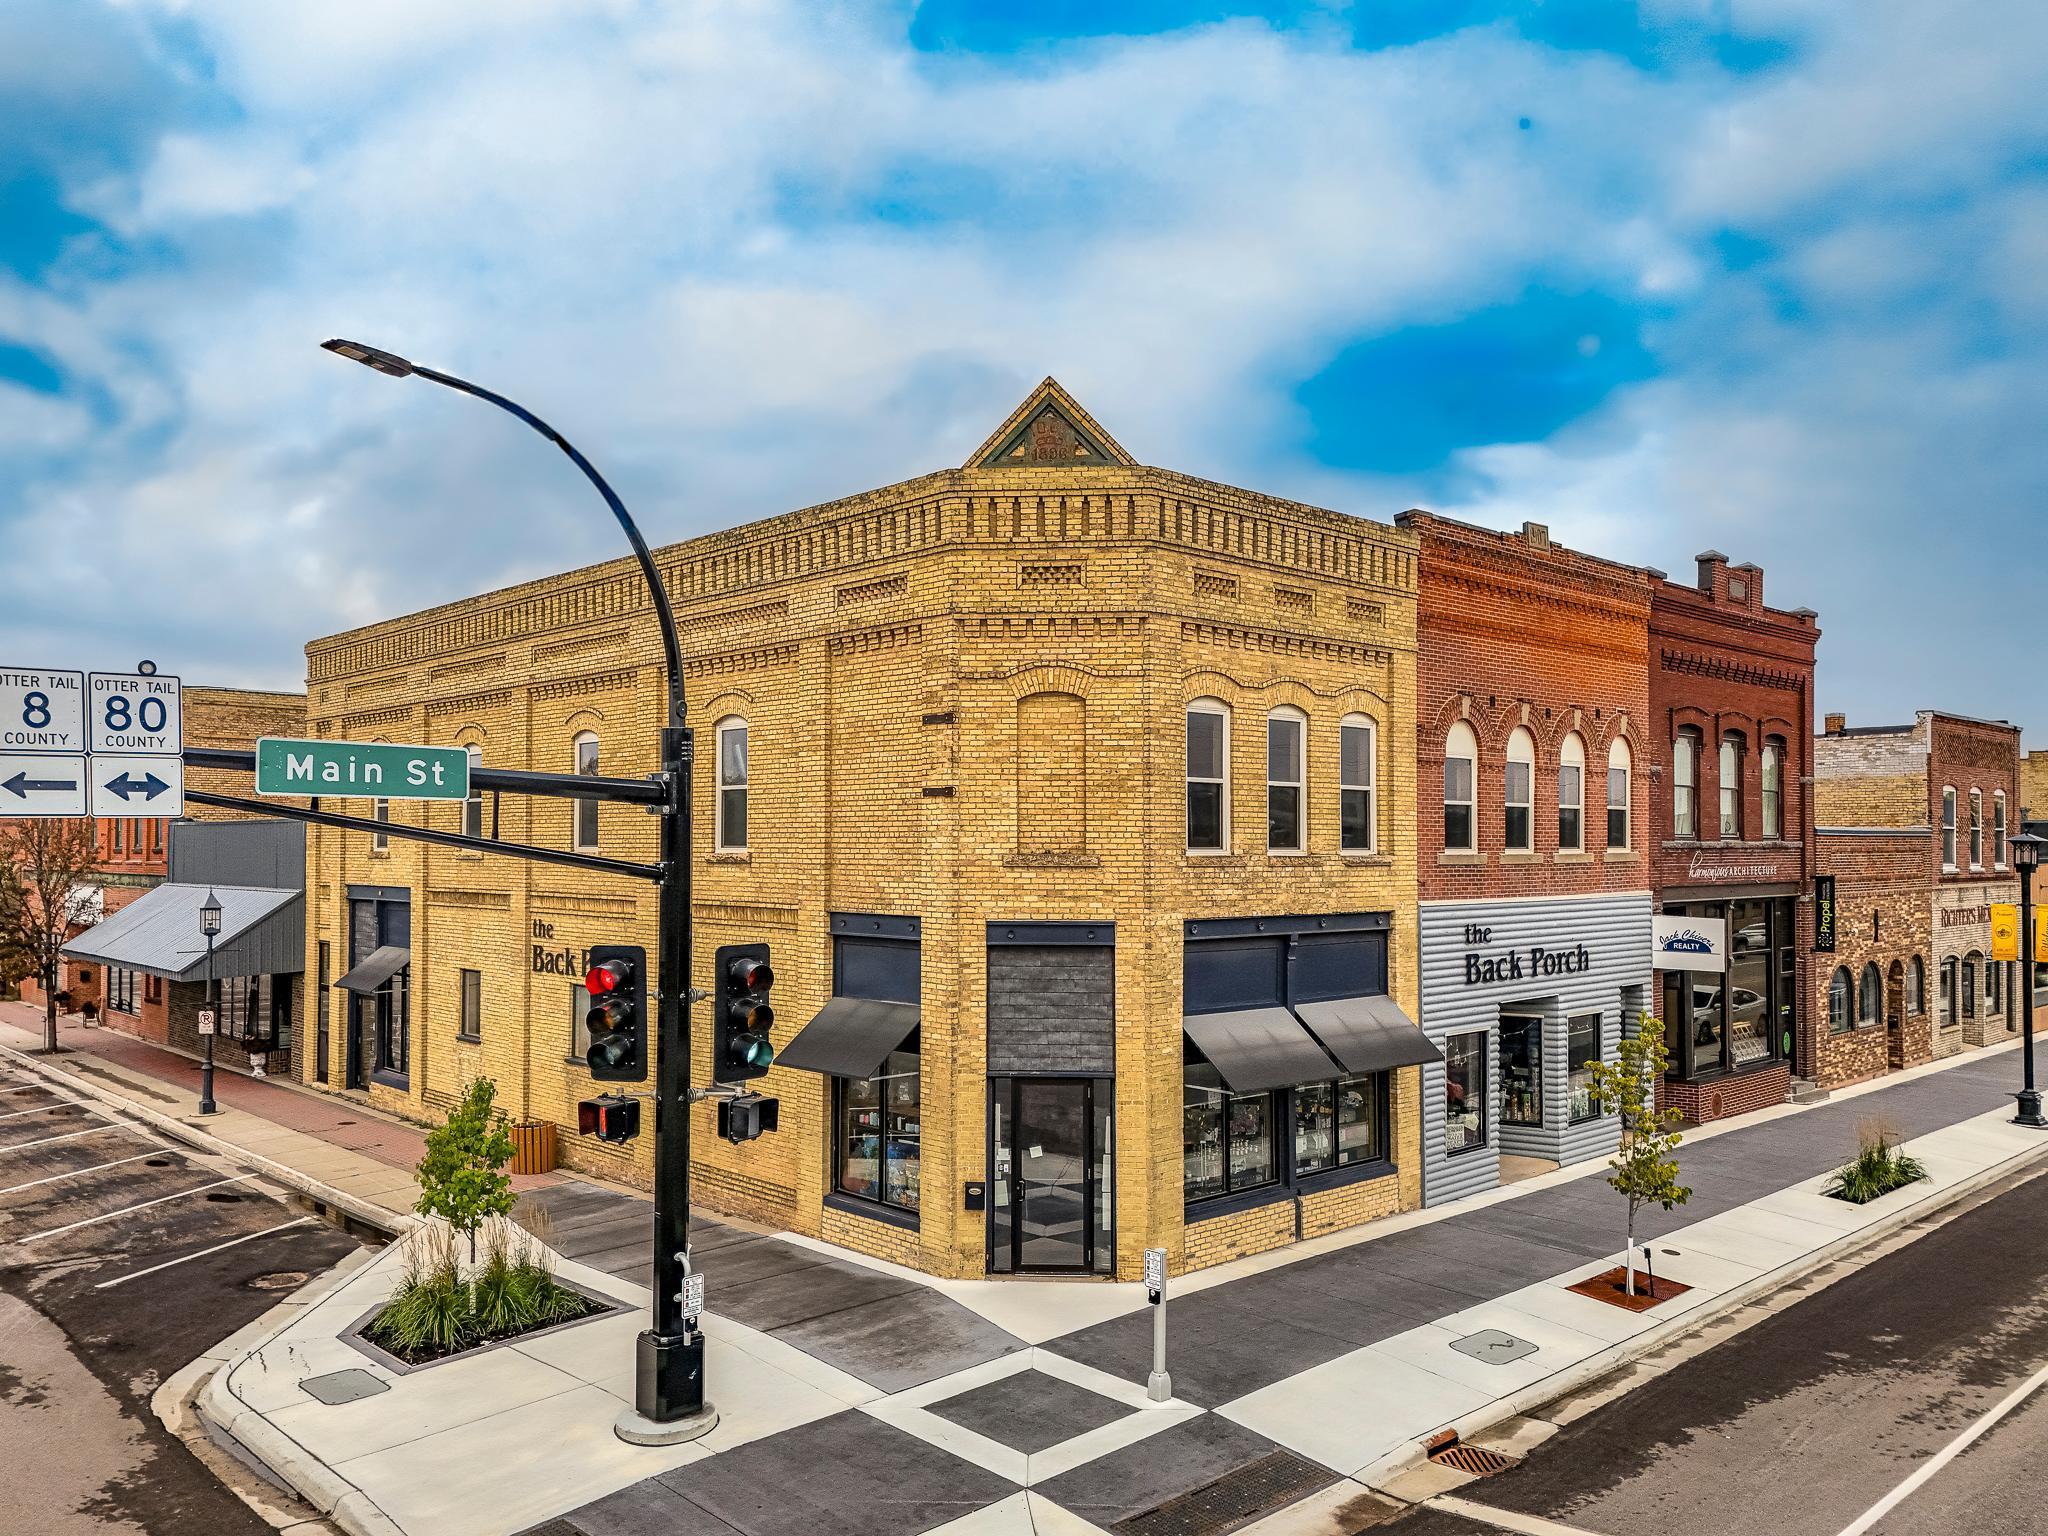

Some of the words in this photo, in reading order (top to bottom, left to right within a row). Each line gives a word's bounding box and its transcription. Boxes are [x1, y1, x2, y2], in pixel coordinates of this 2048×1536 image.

[48, 676, 79, 690] TAIL
[94, 679, 139, 693] OTTER
[146, 681, 175, 694] TAIL
[22, 691, 51, 729] 8
[104, 695, 167, 732] 80
[4, 731, 69, 746] COUNTY
[105, 735, 166, 748] COUNTY
[287, 753, 382, 783] Main
[406, 760, 445, 786] St
[1820, 900, 1833, 932] Propel
[533, 918, 554, 939] the
[1464, 923, 1493, 944] the
[1660, 930, 1679, 949] Jack
[1673, 942, 1700, 950] REALTY
[532, 945, 577, 977] Back
[1464, 949, 1524, 985] Back
[1531, 943, 1590, 978] Porch
